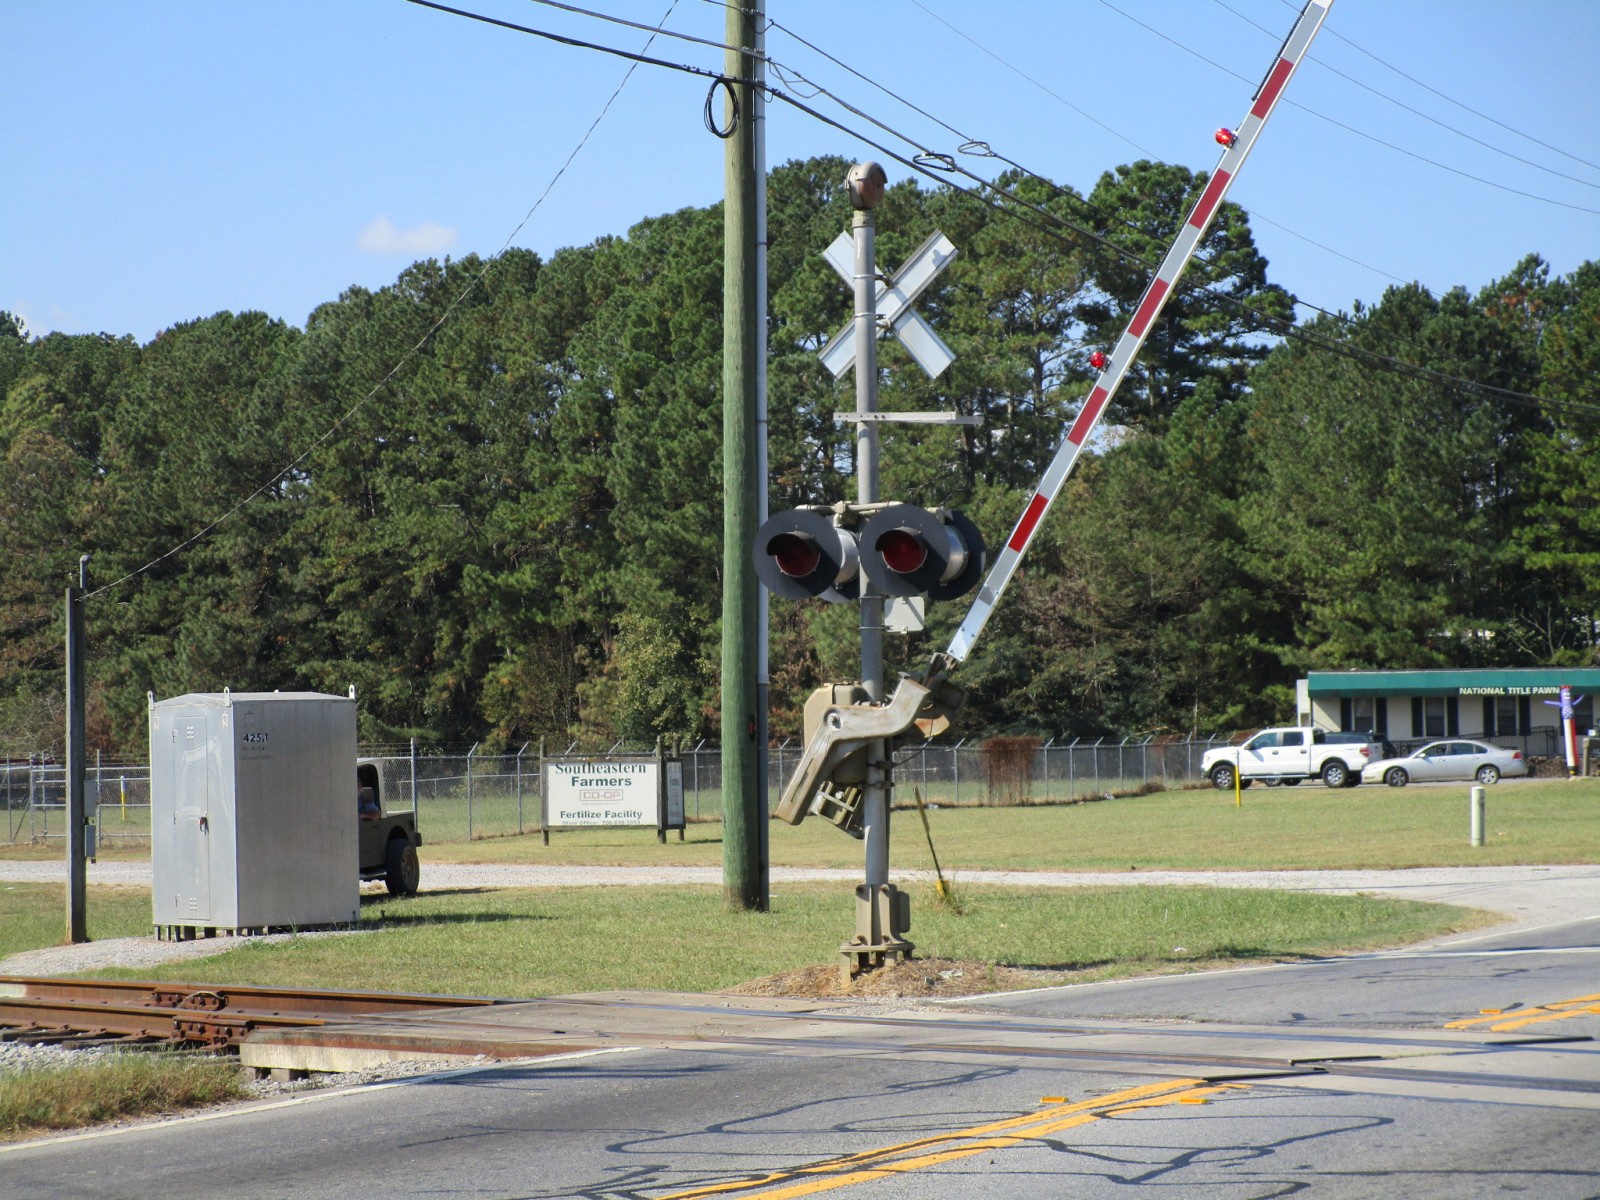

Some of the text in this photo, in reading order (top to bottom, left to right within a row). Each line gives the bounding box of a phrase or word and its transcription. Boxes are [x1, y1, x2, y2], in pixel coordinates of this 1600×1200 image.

[1459, 687, 1505, 695] NATIONAL
[1508, 687, 1531, 695] TITLE
[555, 762, 646, 774] Southeastern
[571, 776, 632, 787] Farmers
[583, 791, 620, 799] CO-OP
[560, 810, 643, 820] Fertilize Facility
